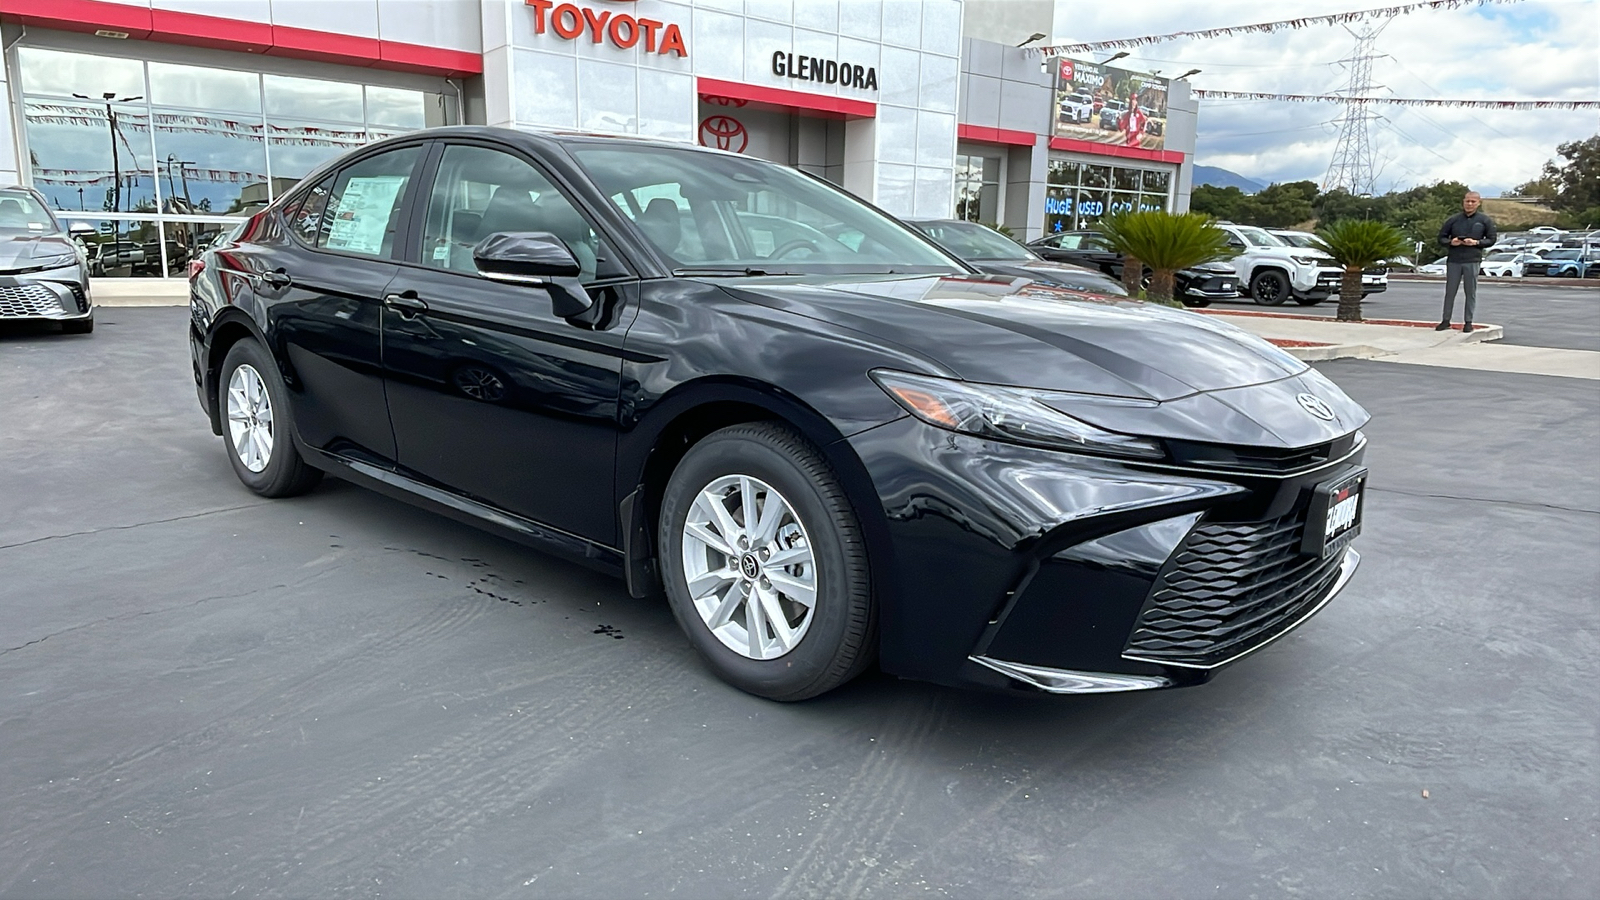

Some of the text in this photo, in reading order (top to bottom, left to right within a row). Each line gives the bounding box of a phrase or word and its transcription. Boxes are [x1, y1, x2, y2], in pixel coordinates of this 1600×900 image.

[525, 0, 688, 57] TOYOTA
[772, 50, 878, 91] GLENDORA
[1073, 71, 1104, 86] MÁXIMO
[1045, 198, 1072, 216] HUGE
[1078, 201, 1103, 216] USED
